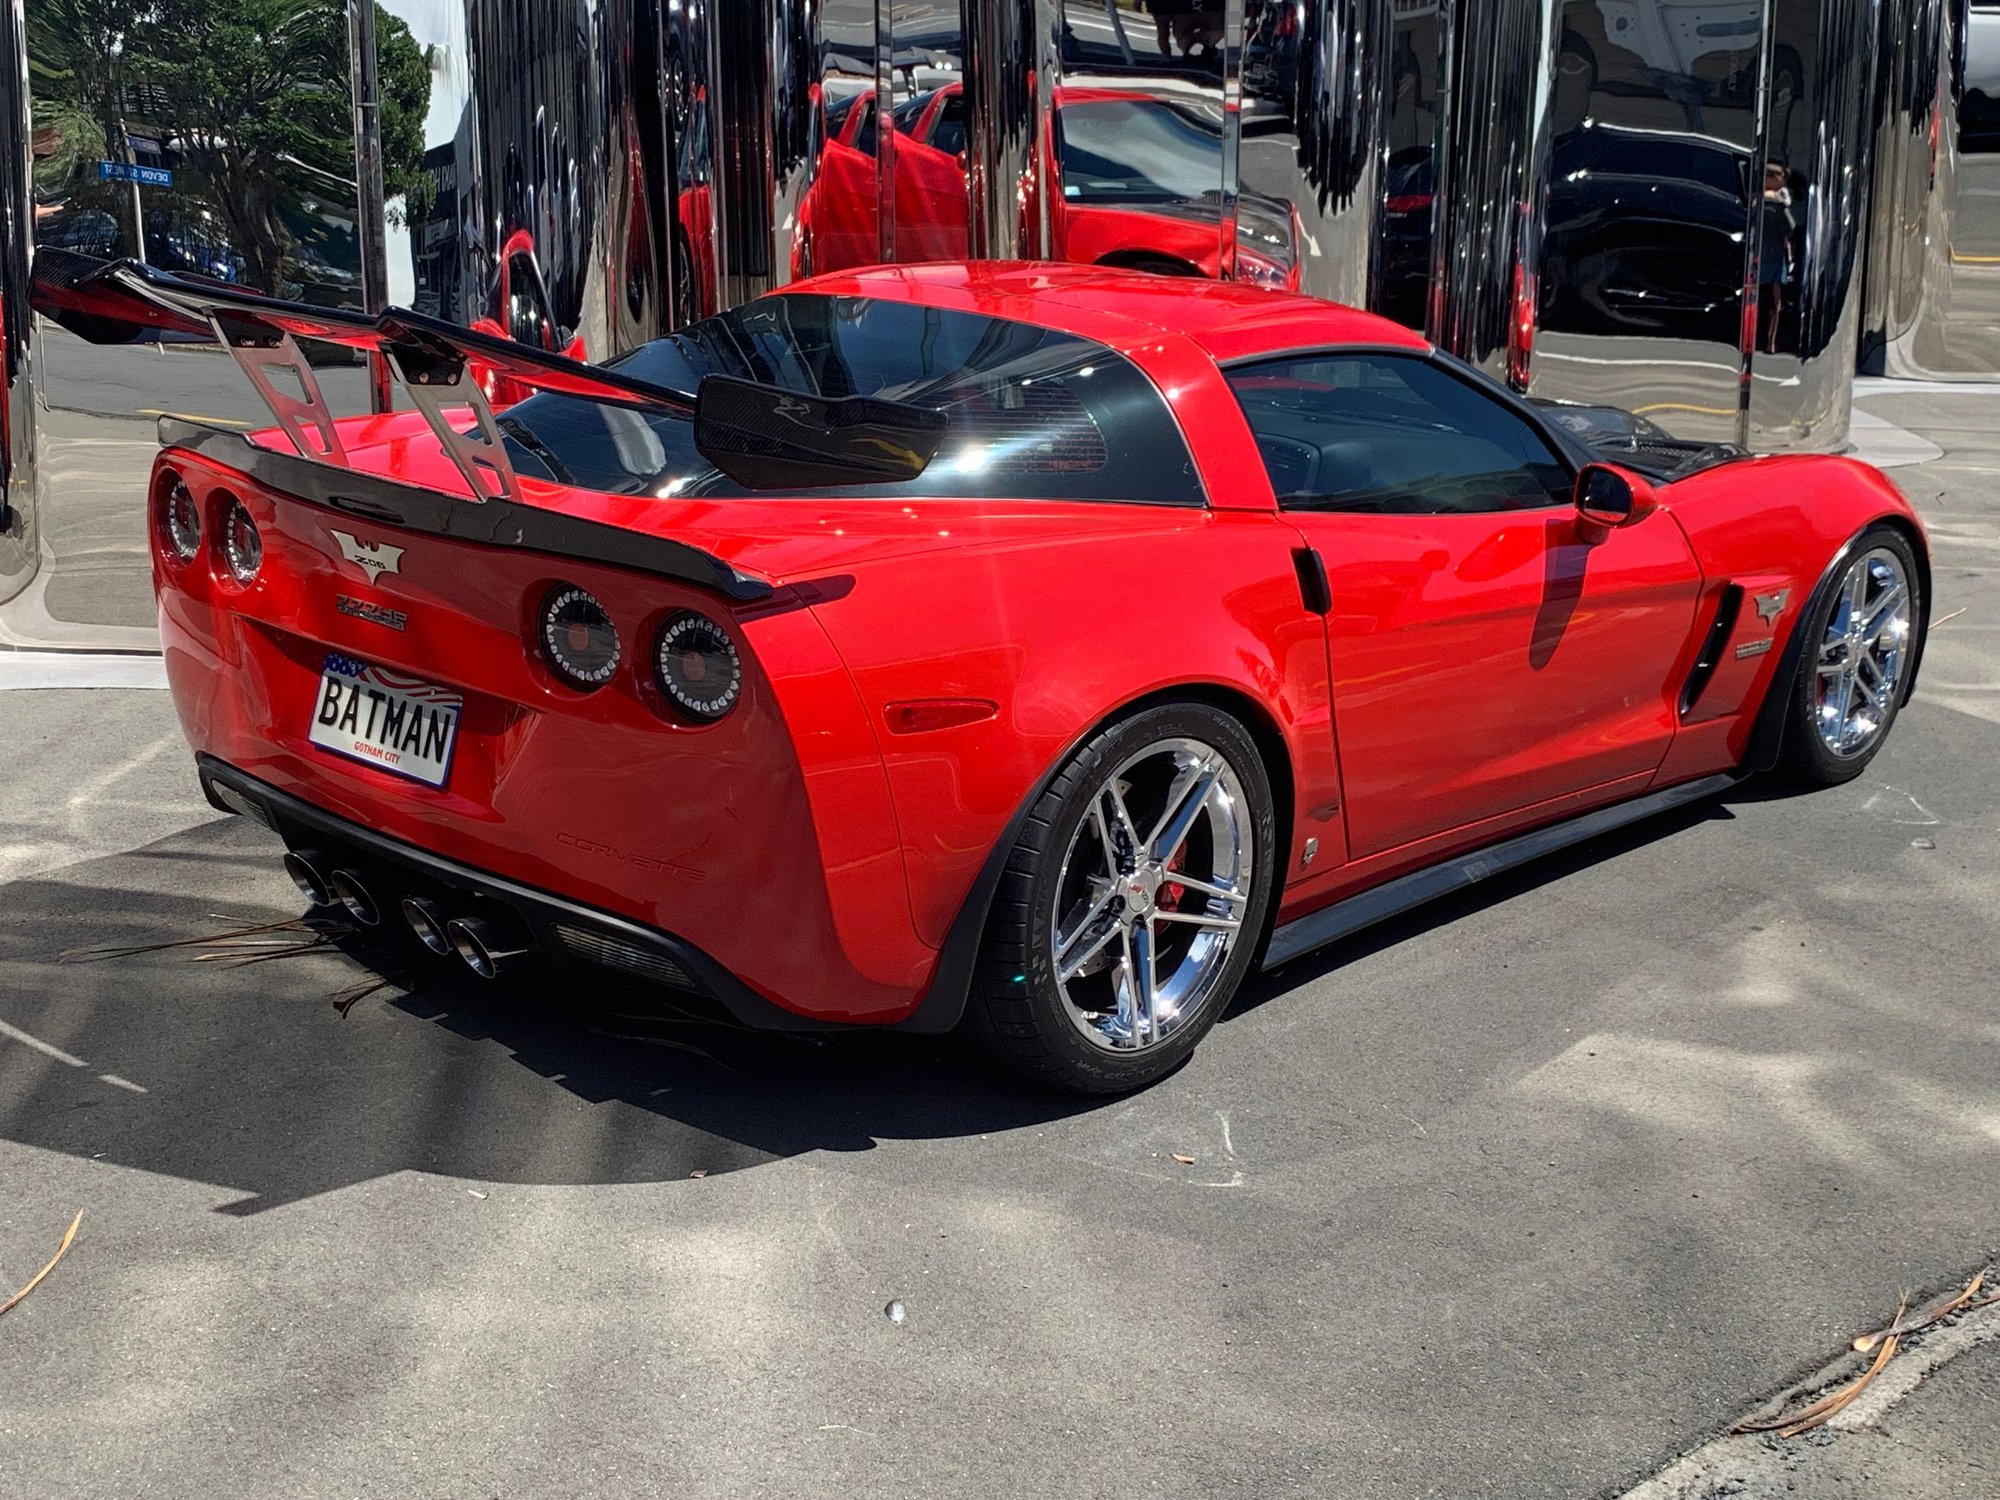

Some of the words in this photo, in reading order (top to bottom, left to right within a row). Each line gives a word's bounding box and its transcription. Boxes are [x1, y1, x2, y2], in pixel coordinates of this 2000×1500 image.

[318, 676, 451, 764] BATMAN
[354, 741, 384, 759] GOTHAM
[384, 751, 401, 765] CITY
[556, 832, 711, 881] CORVETTE
